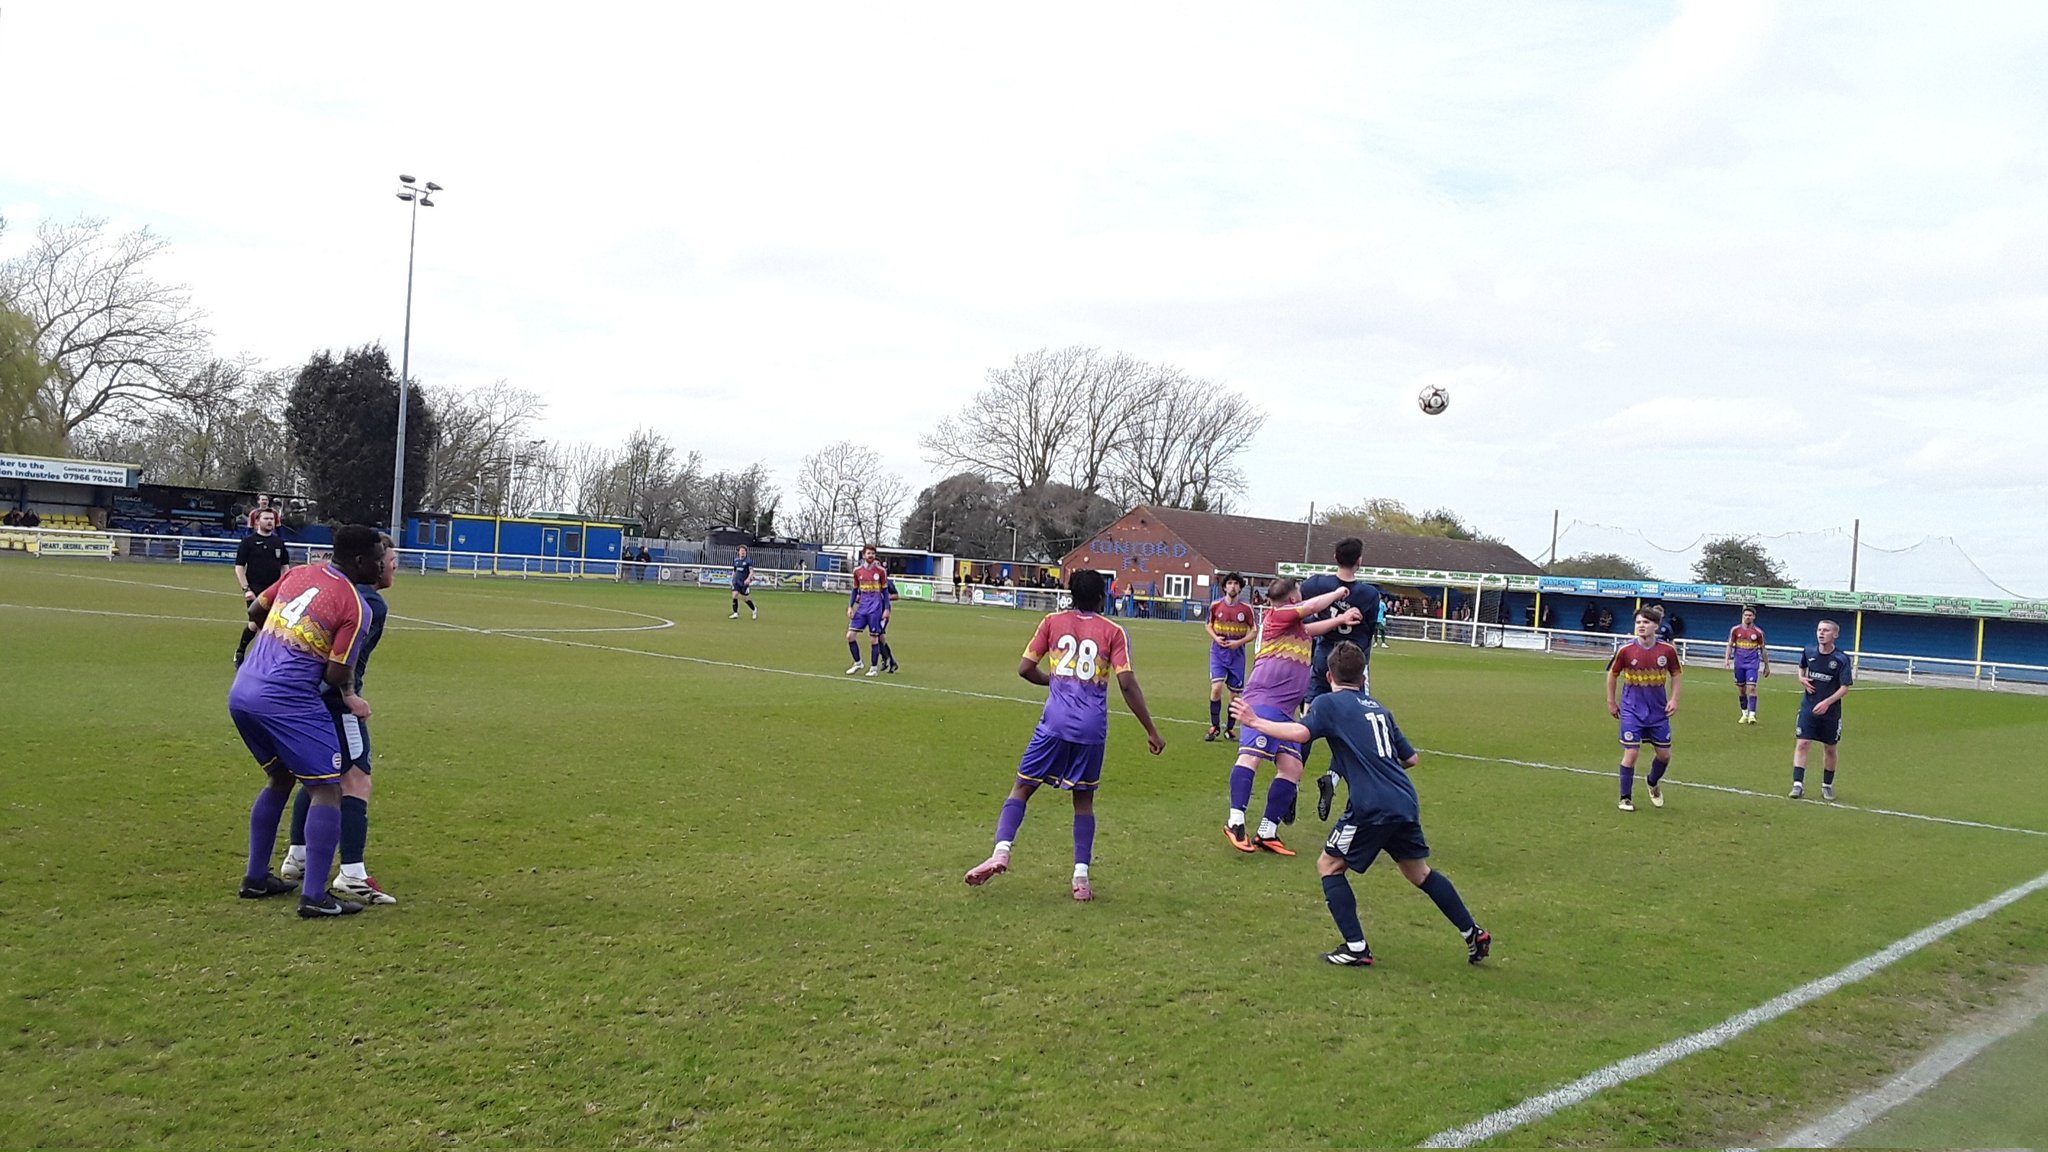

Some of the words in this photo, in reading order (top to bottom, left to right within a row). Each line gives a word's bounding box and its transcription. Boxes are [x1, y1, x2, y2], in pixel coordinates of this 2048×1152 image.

[30, 461, 44, 470] the
[62, 473, 90, 481] 07966
[92, 475, 124, 484] 704536
[1090, 539, 1188, 558] CONCORD
[280, 586, 320, 629] 4
[1055, 634, 1098, 681] 28
[1364, 712, 1392, 759] 11
